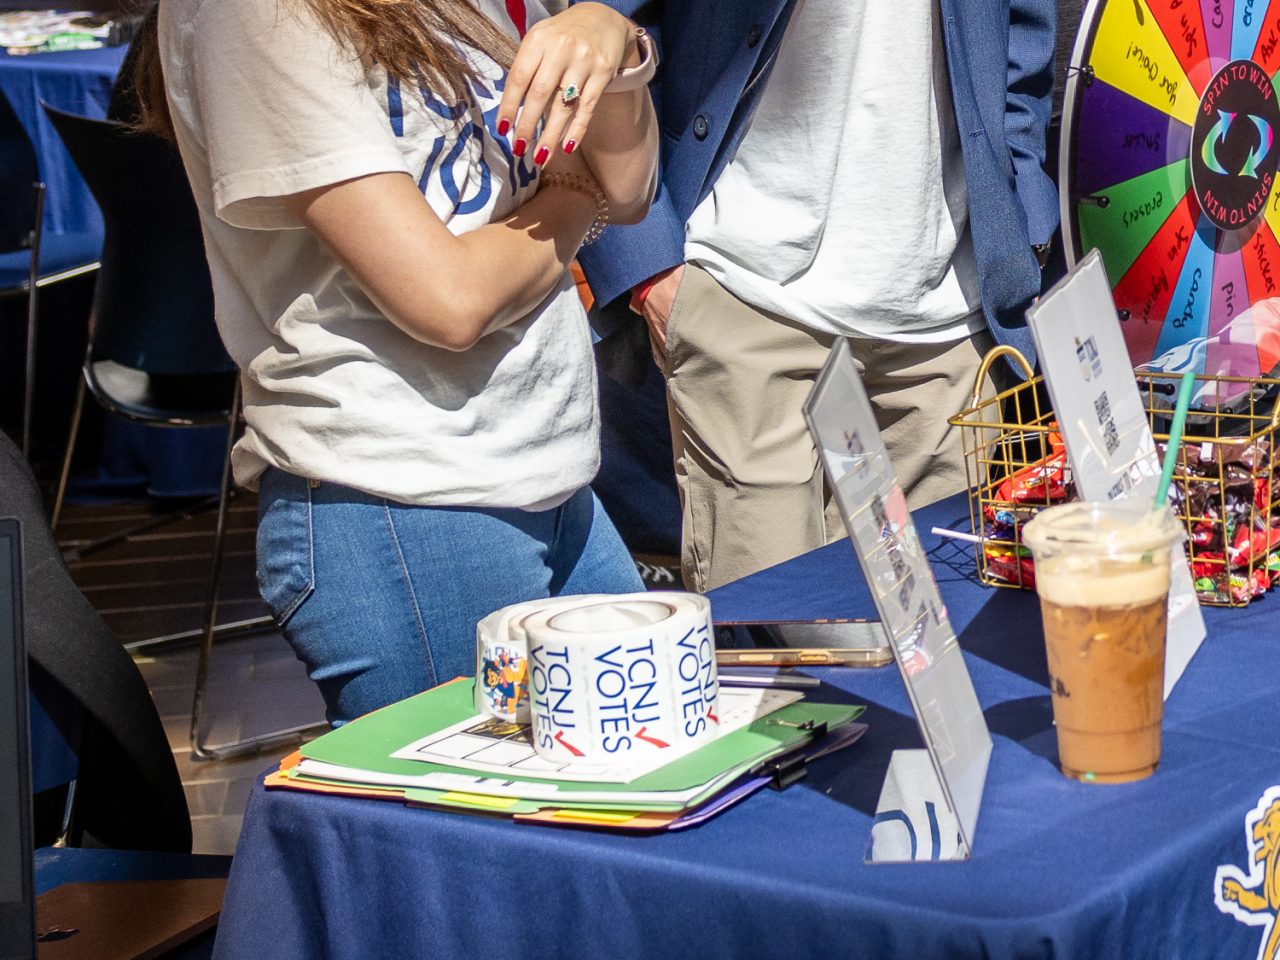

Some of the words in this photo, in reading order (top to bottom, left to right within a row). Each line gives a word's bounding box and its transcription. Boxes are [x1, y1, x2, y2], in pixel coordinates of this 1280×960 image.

[1181, 14, 1198, 58] Spin
[1260, 29, 1279, 65] Ask
[1203, 71, 1229, 116] SPIN
[1230, 64, 1248, 81] TO
[1249, 66, 1273, 101] WIN
[1203, 189, 1228, 224] WIN
[1229, 206, 1247, 225] TO
[1247, 172, 1273, 216] SPIN
[1167, 225, 1190, 263] Spin
[626, 638, 661, 723] TCNJ
[676, 626, 706, 738] VOTES
[697, 617, 717, 703] TCNJ
[530, 645, 553, 751] VOTES
[546, 646, 575, 729] TCNJ
[594, 645, 632, 754] VOTES
